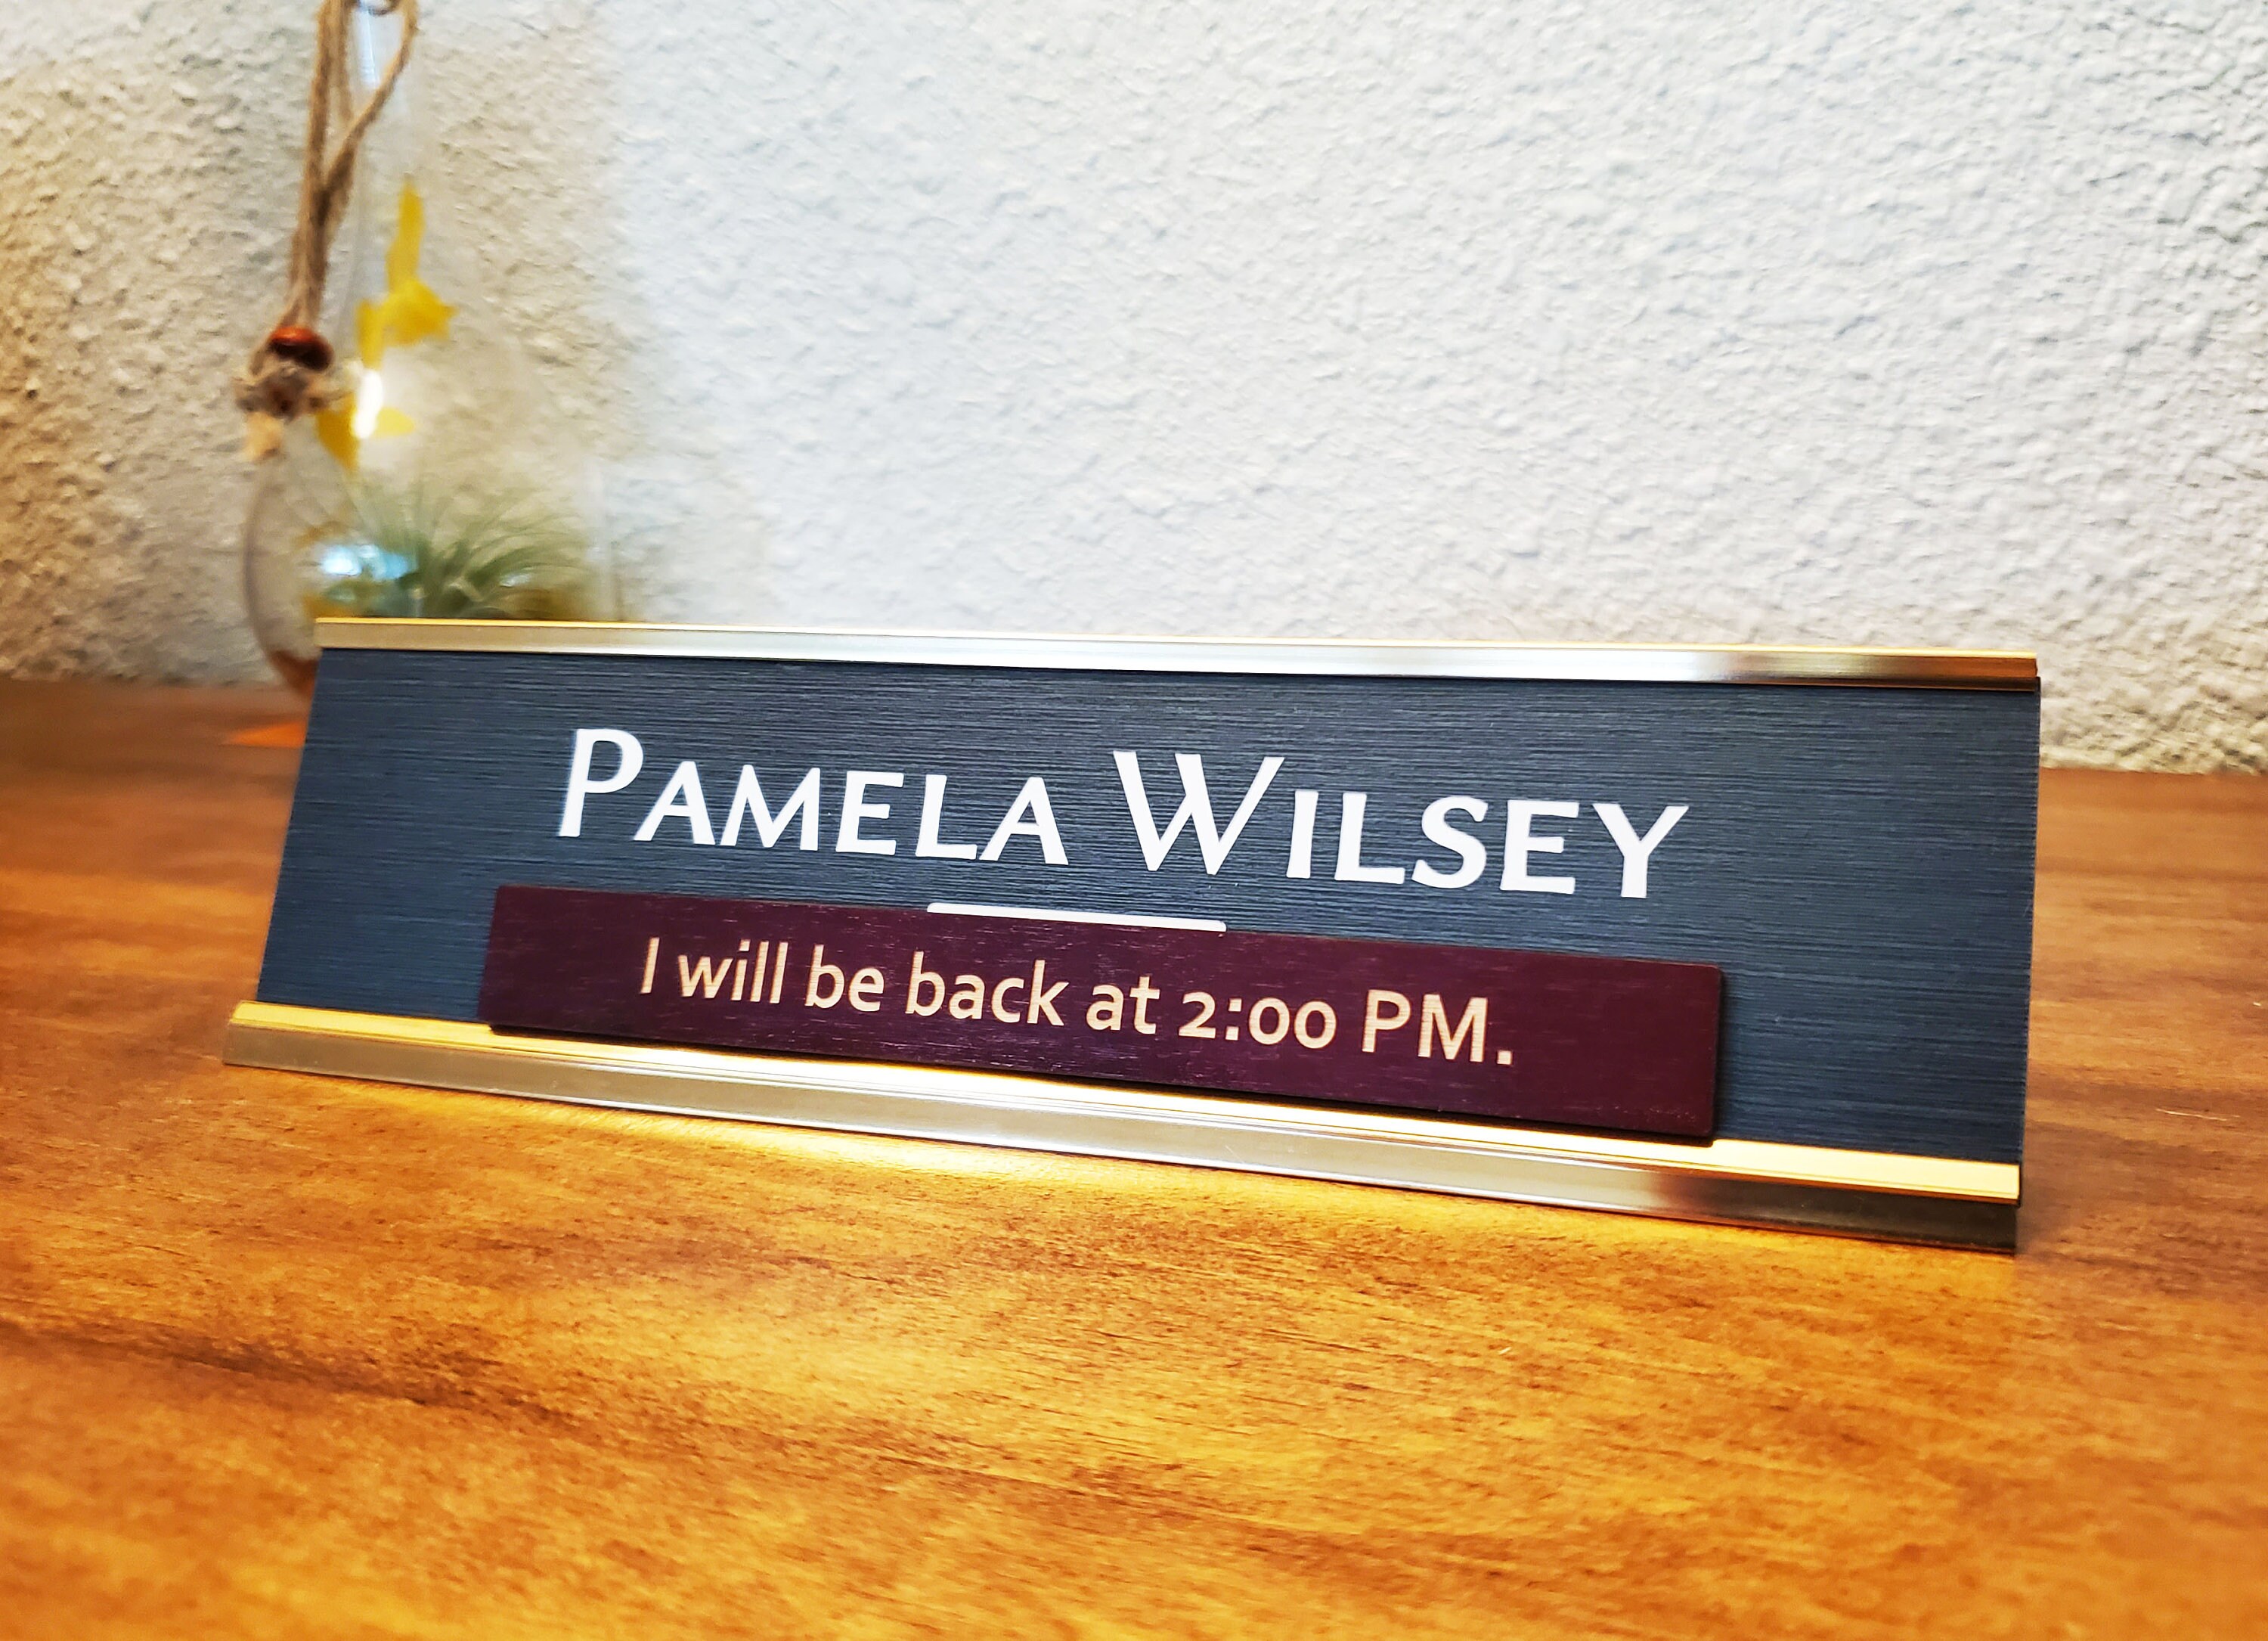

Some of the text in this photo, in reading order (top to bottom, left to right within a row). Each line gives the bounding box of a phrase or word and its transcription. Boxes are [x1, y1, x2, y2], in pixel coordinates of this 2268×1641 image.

[556, 727, 1690, 900] PAMELA WILSEY
[640, 936, 1514, 1066] I will be back at 2:00 PM.
